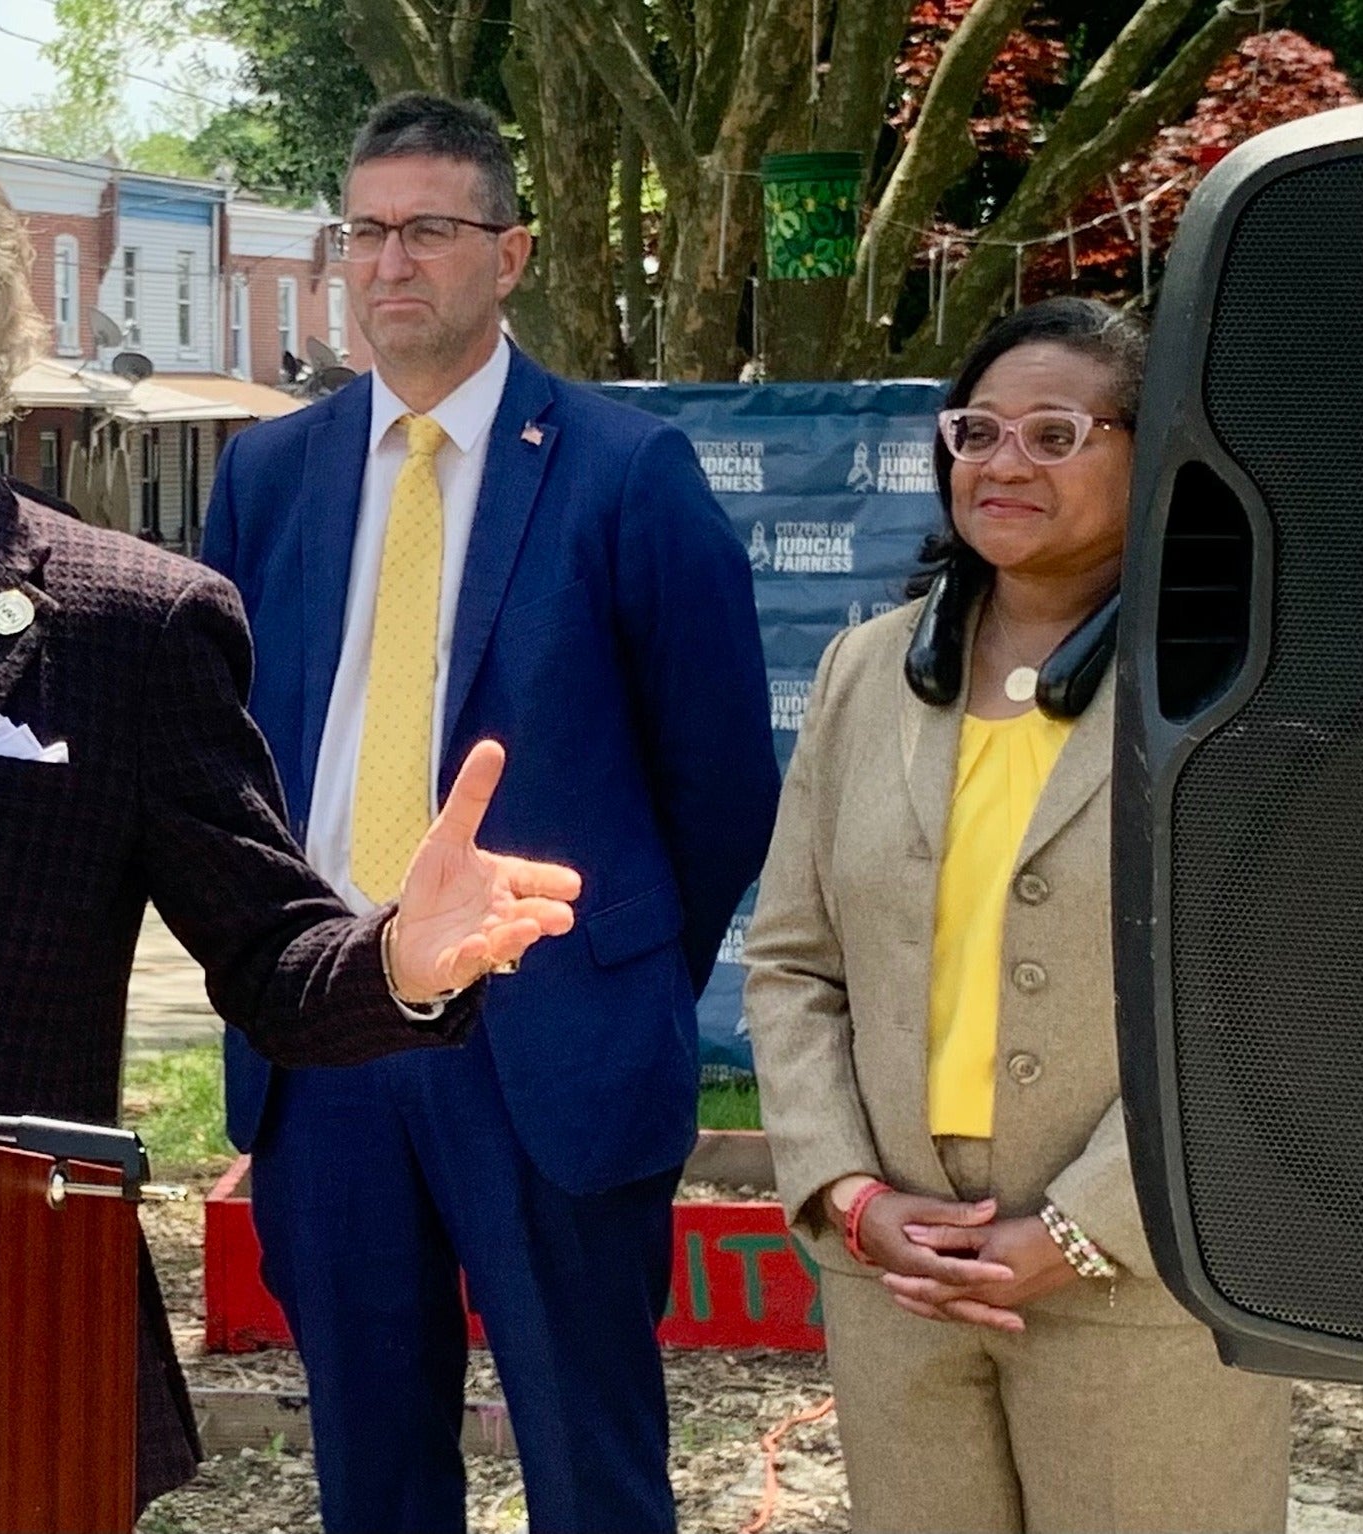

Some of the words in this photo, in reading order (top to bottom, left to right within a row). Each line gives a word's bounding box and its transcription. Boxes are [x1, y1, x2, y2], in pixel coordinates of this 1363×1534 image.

[740, 441, 765, 456] FOR
[878, 457, 934, 475] JUDICI
[775, 522, 829, 537] CITIZENS
[830, 522, 855, 537] FOR
[775, 537, 853, 555] JUDICIAL
[774, 555, 853, 573] FAIRNESS
